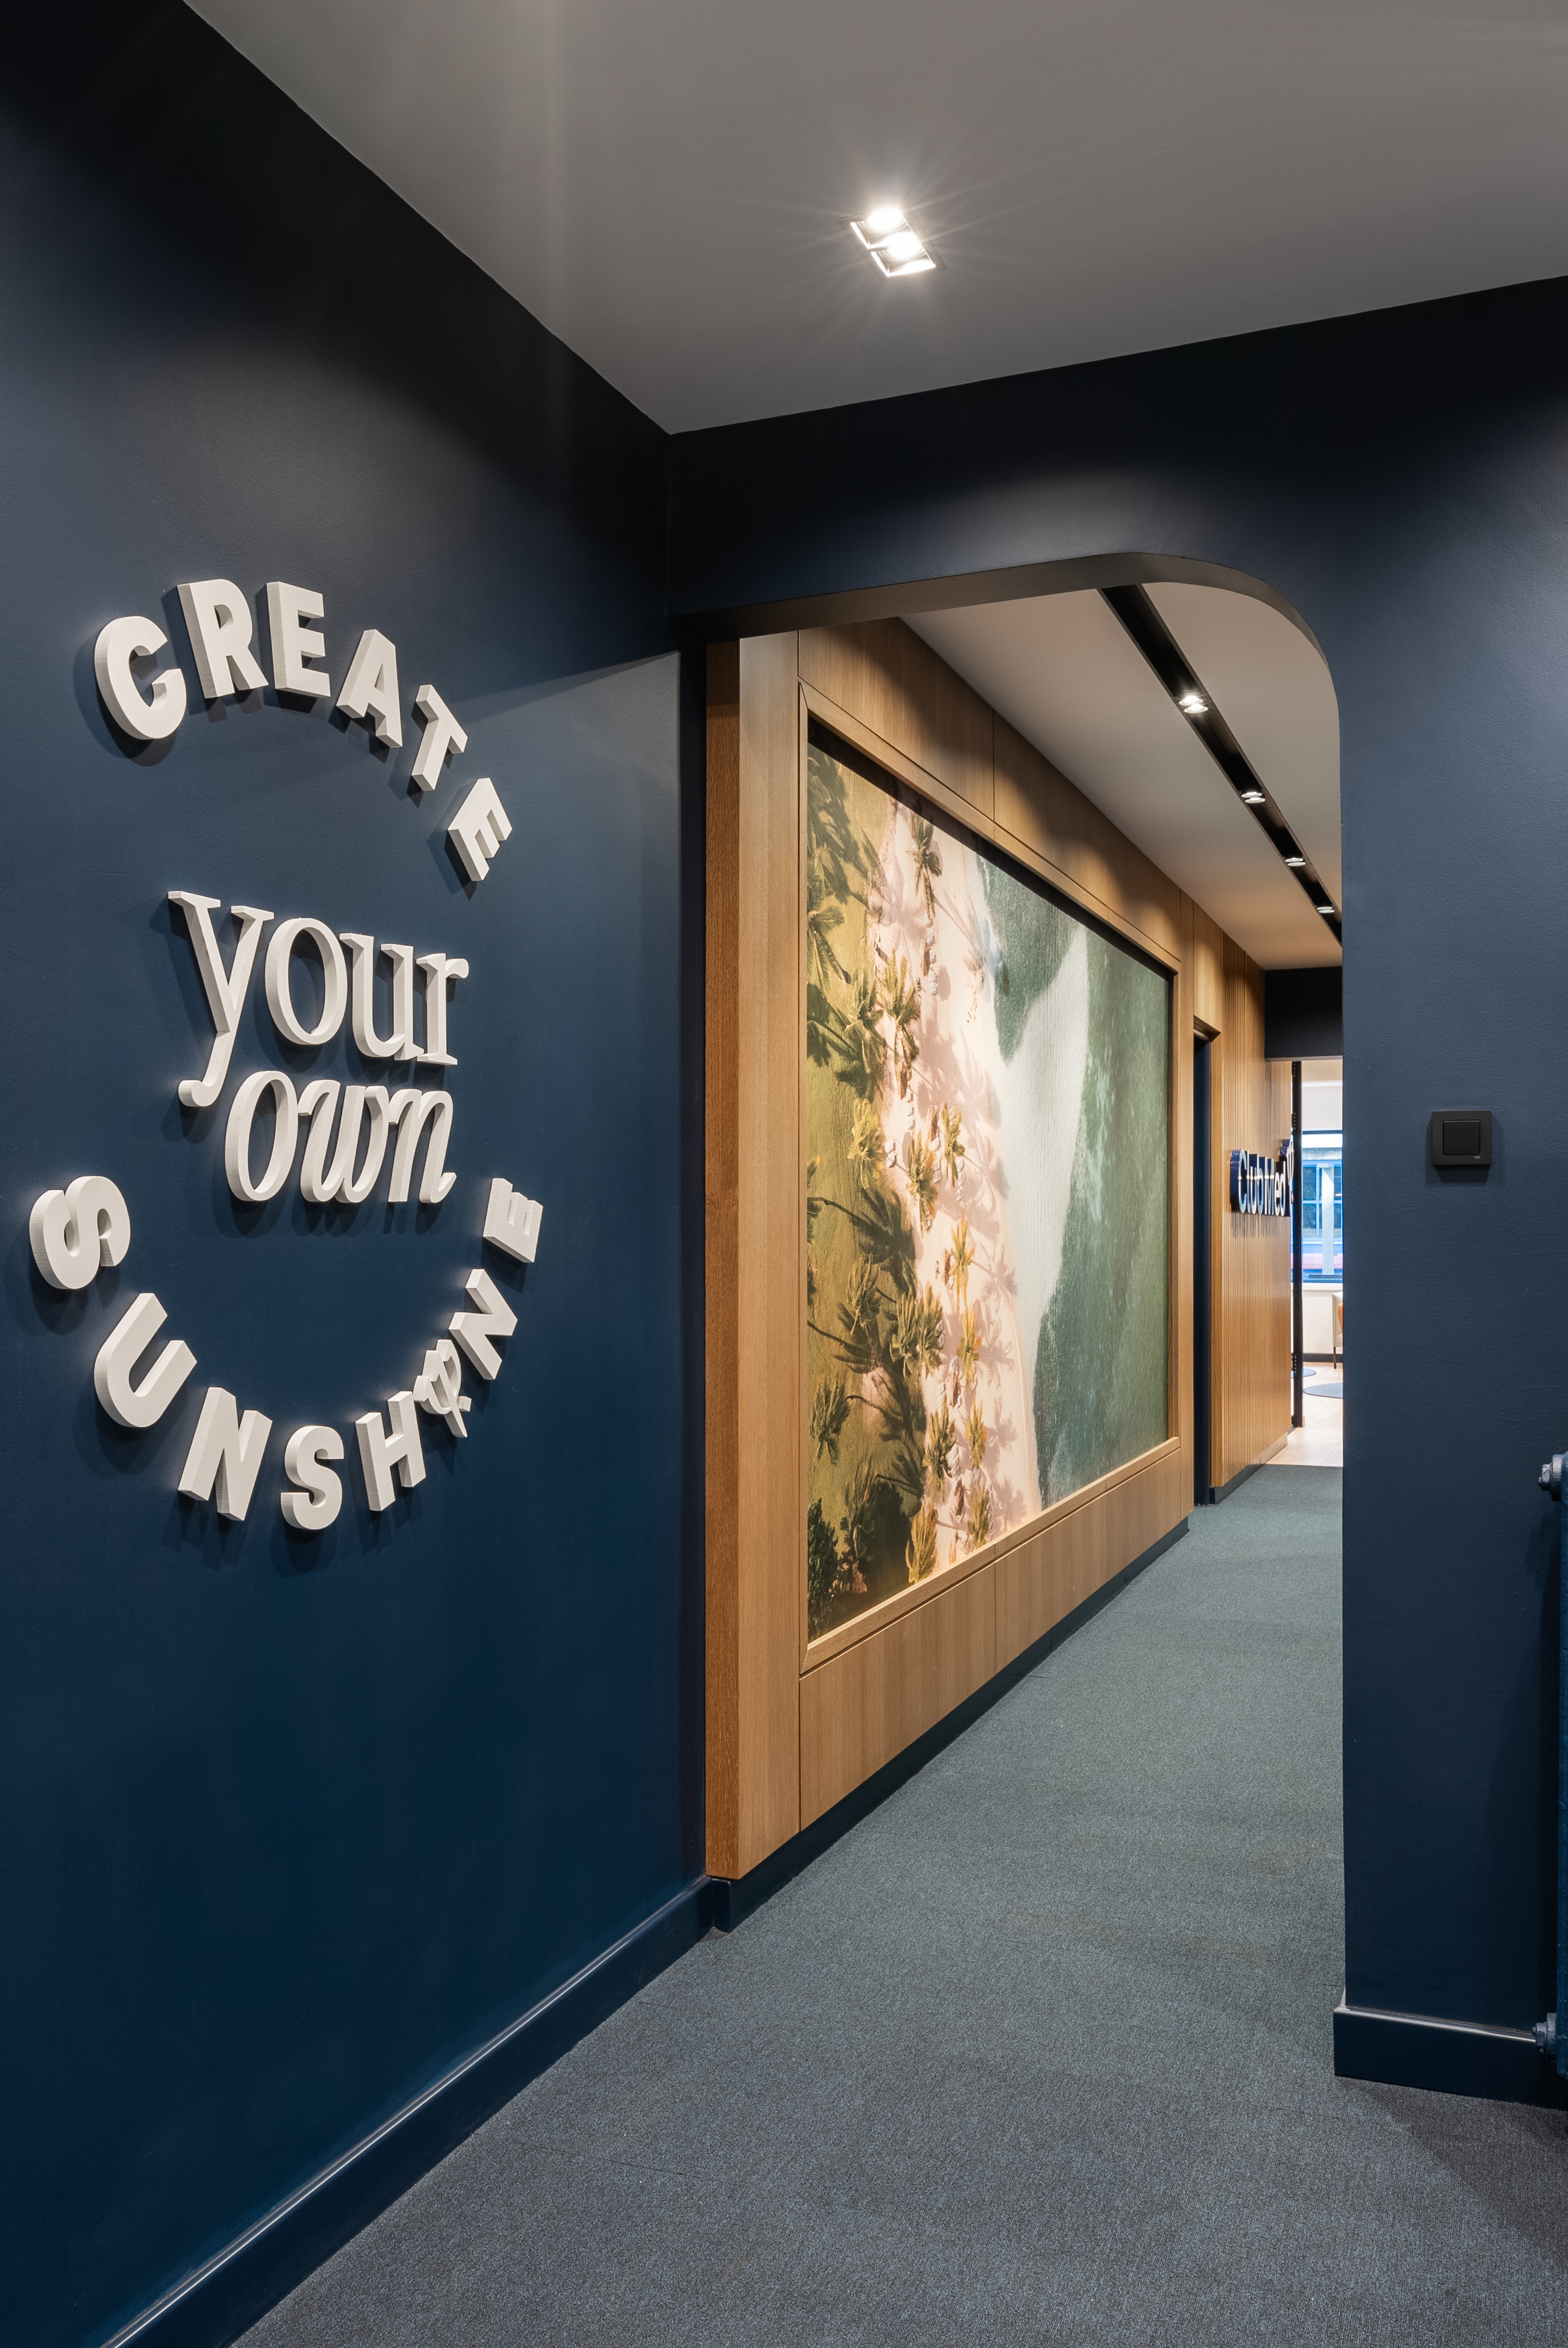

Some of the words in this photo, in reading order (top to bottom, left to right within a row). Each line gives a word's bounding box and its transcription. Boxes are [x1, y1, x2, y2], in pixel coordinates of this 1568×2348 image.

[93, 578, 513, 882] CREATE
[168, 890, 470, 1108] your
[224, 1069, 457, 1203] own
